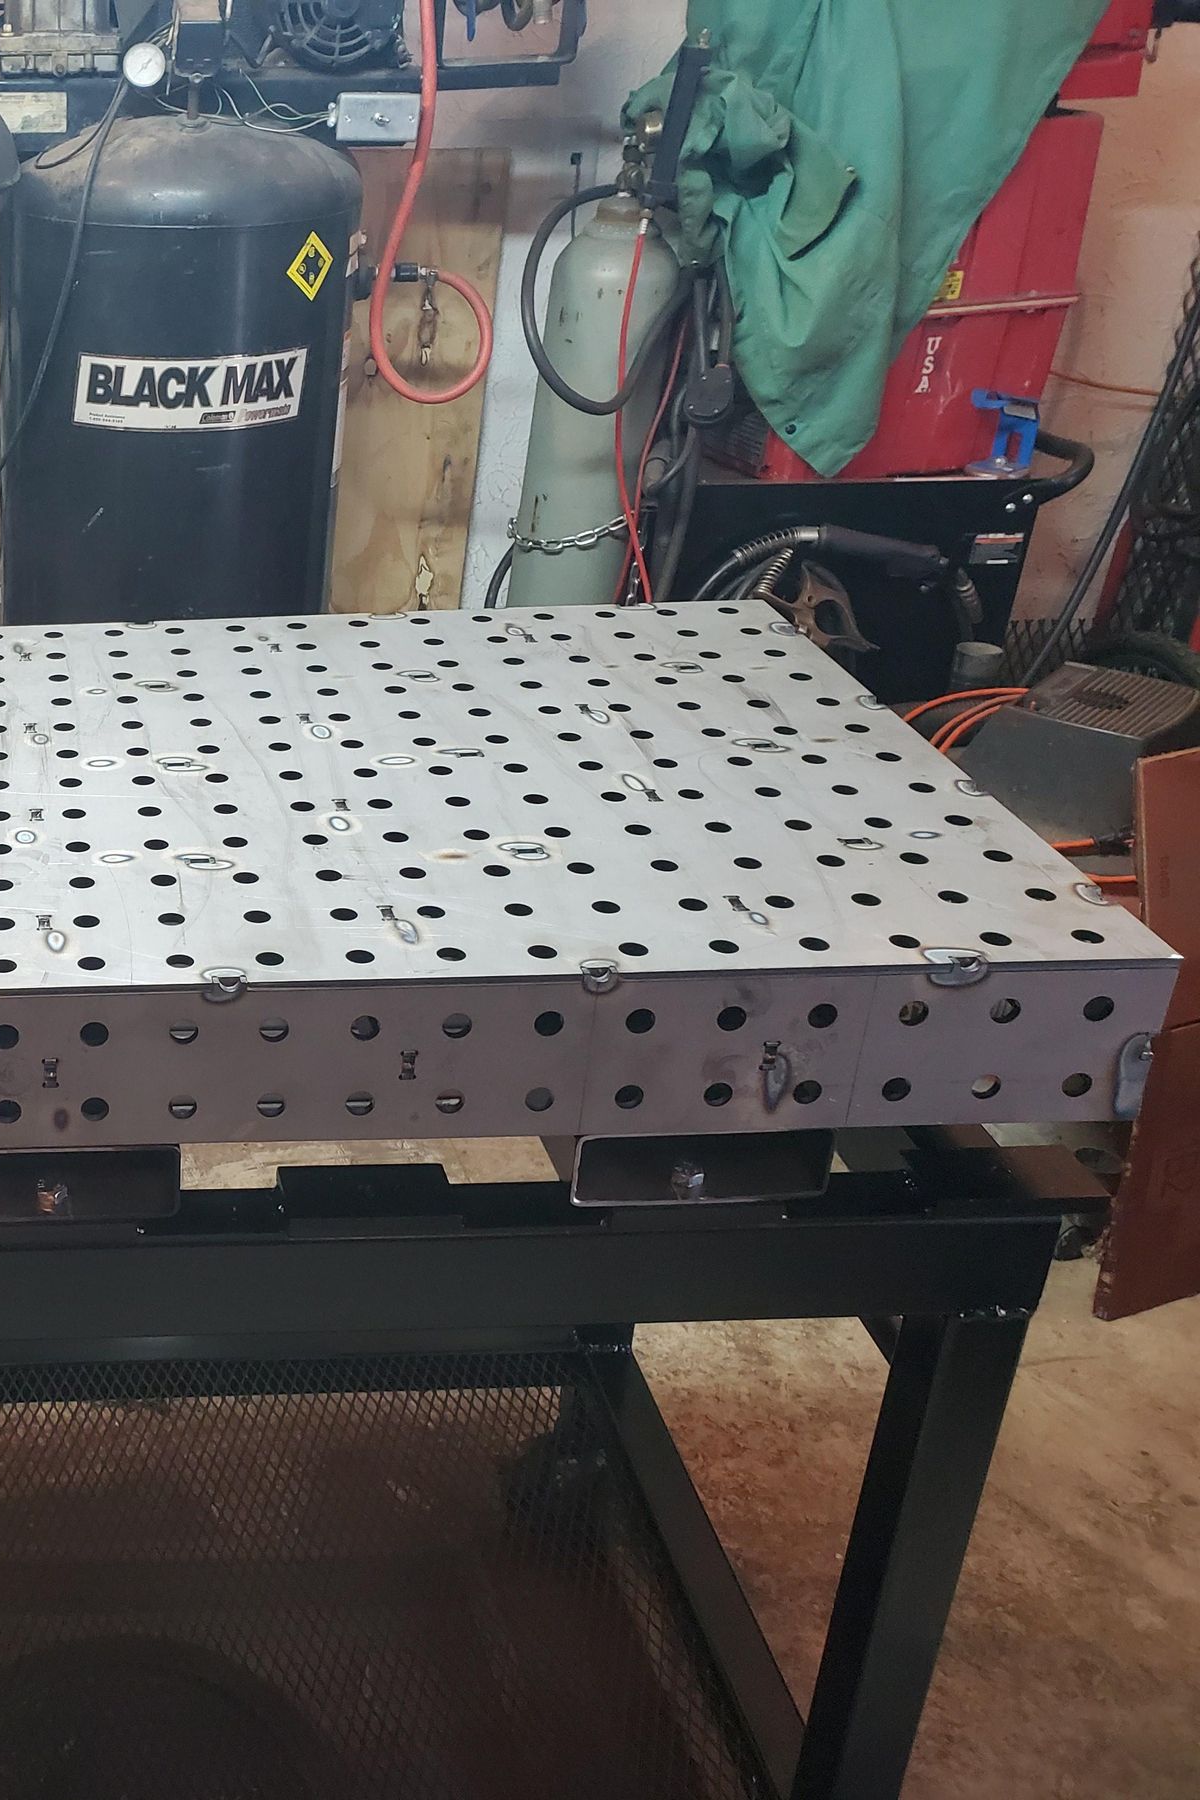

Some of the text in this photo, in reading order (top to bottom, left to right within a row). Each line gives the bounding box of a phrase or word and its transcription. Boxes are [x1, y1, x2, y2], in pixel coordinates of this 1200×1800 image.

[86, 356, 298, 409] BLACK MAX
[914, 336, 942, 393] USA
